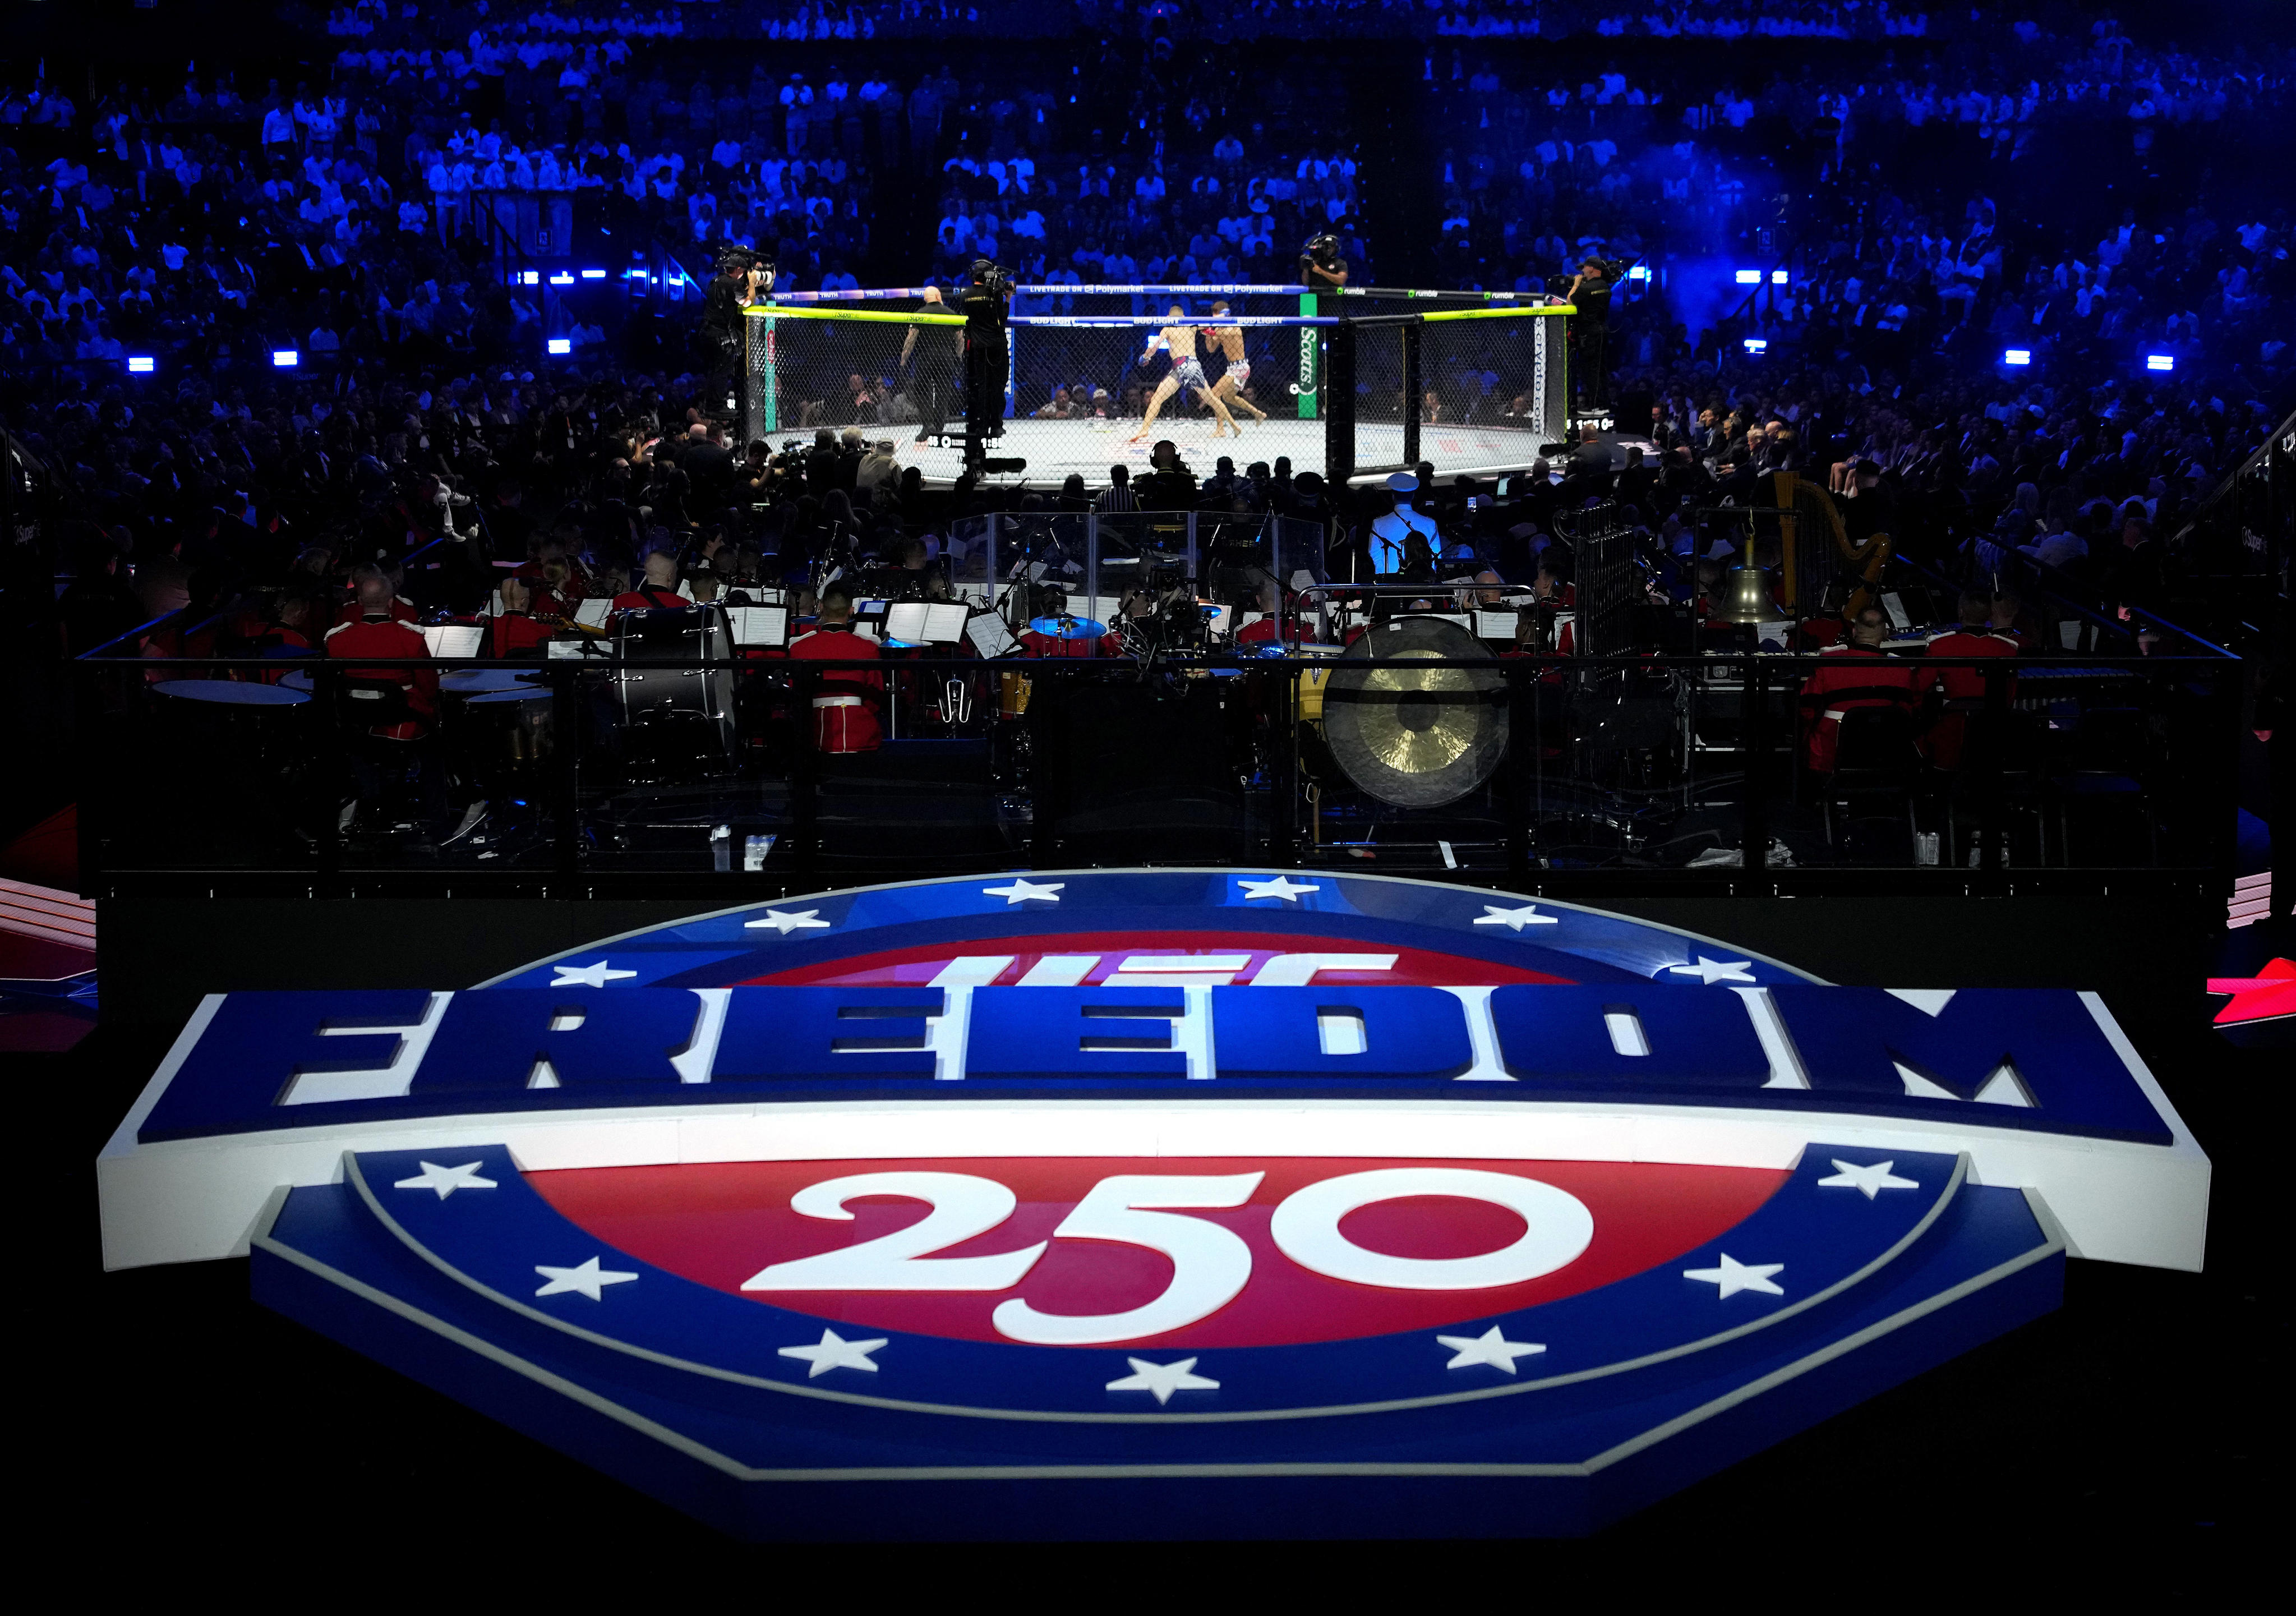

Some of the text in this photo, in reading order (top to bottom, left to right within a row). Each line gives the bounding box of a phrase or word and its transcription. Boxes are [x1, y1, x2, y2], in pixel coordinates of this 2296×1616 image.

[1096, 284, 1144, 293] Polymarket
[1235, 284, 1283, 293] Polymarket
[1415, 289, 1438, 298] rumble
[1491, 291, 1514, 300] rumble
[1534, 332, 1543, 434] crypto.com
[136, 986, 2175, 1145] FREEDOM
[739, 1167, 1595, 1345] 250
